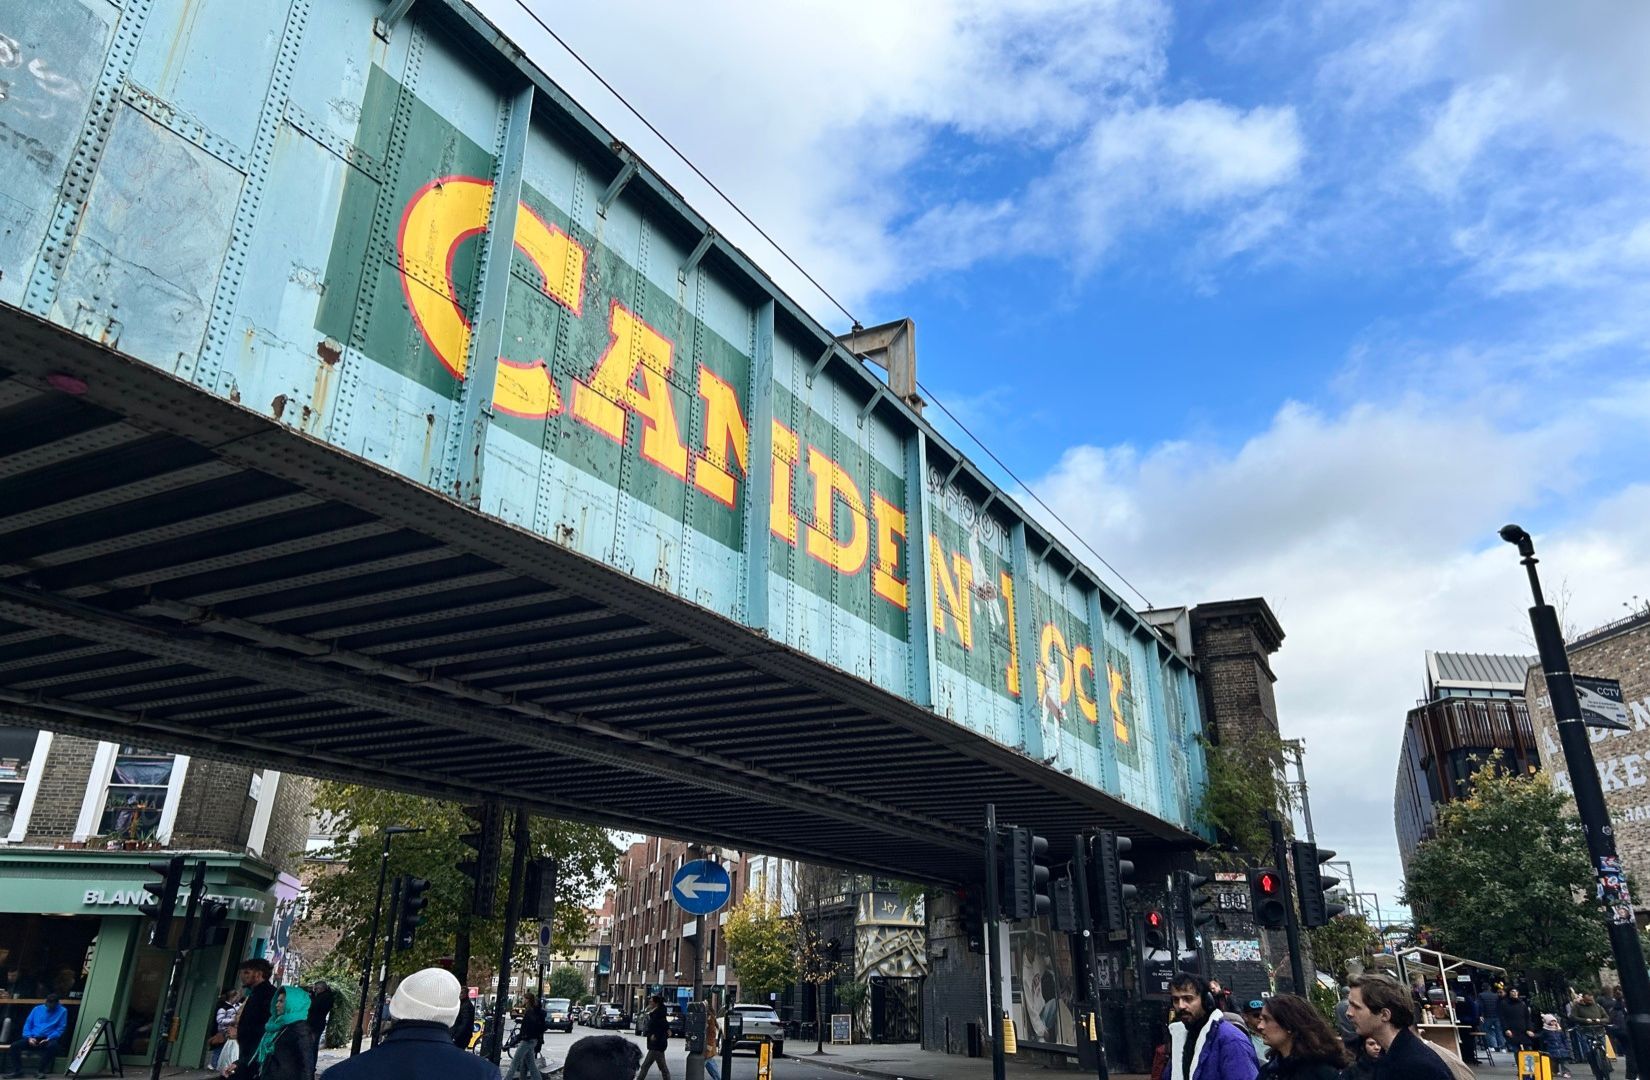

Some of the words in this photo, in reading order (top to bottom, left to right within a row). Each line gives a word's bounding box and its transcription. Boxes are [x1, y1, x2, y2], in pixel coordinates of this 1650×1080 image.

[396, 174, 974, 651] CAMDEN
[1596, 687, 1620, 697] CCTV
[82, 889, 155, 906] BLANK
